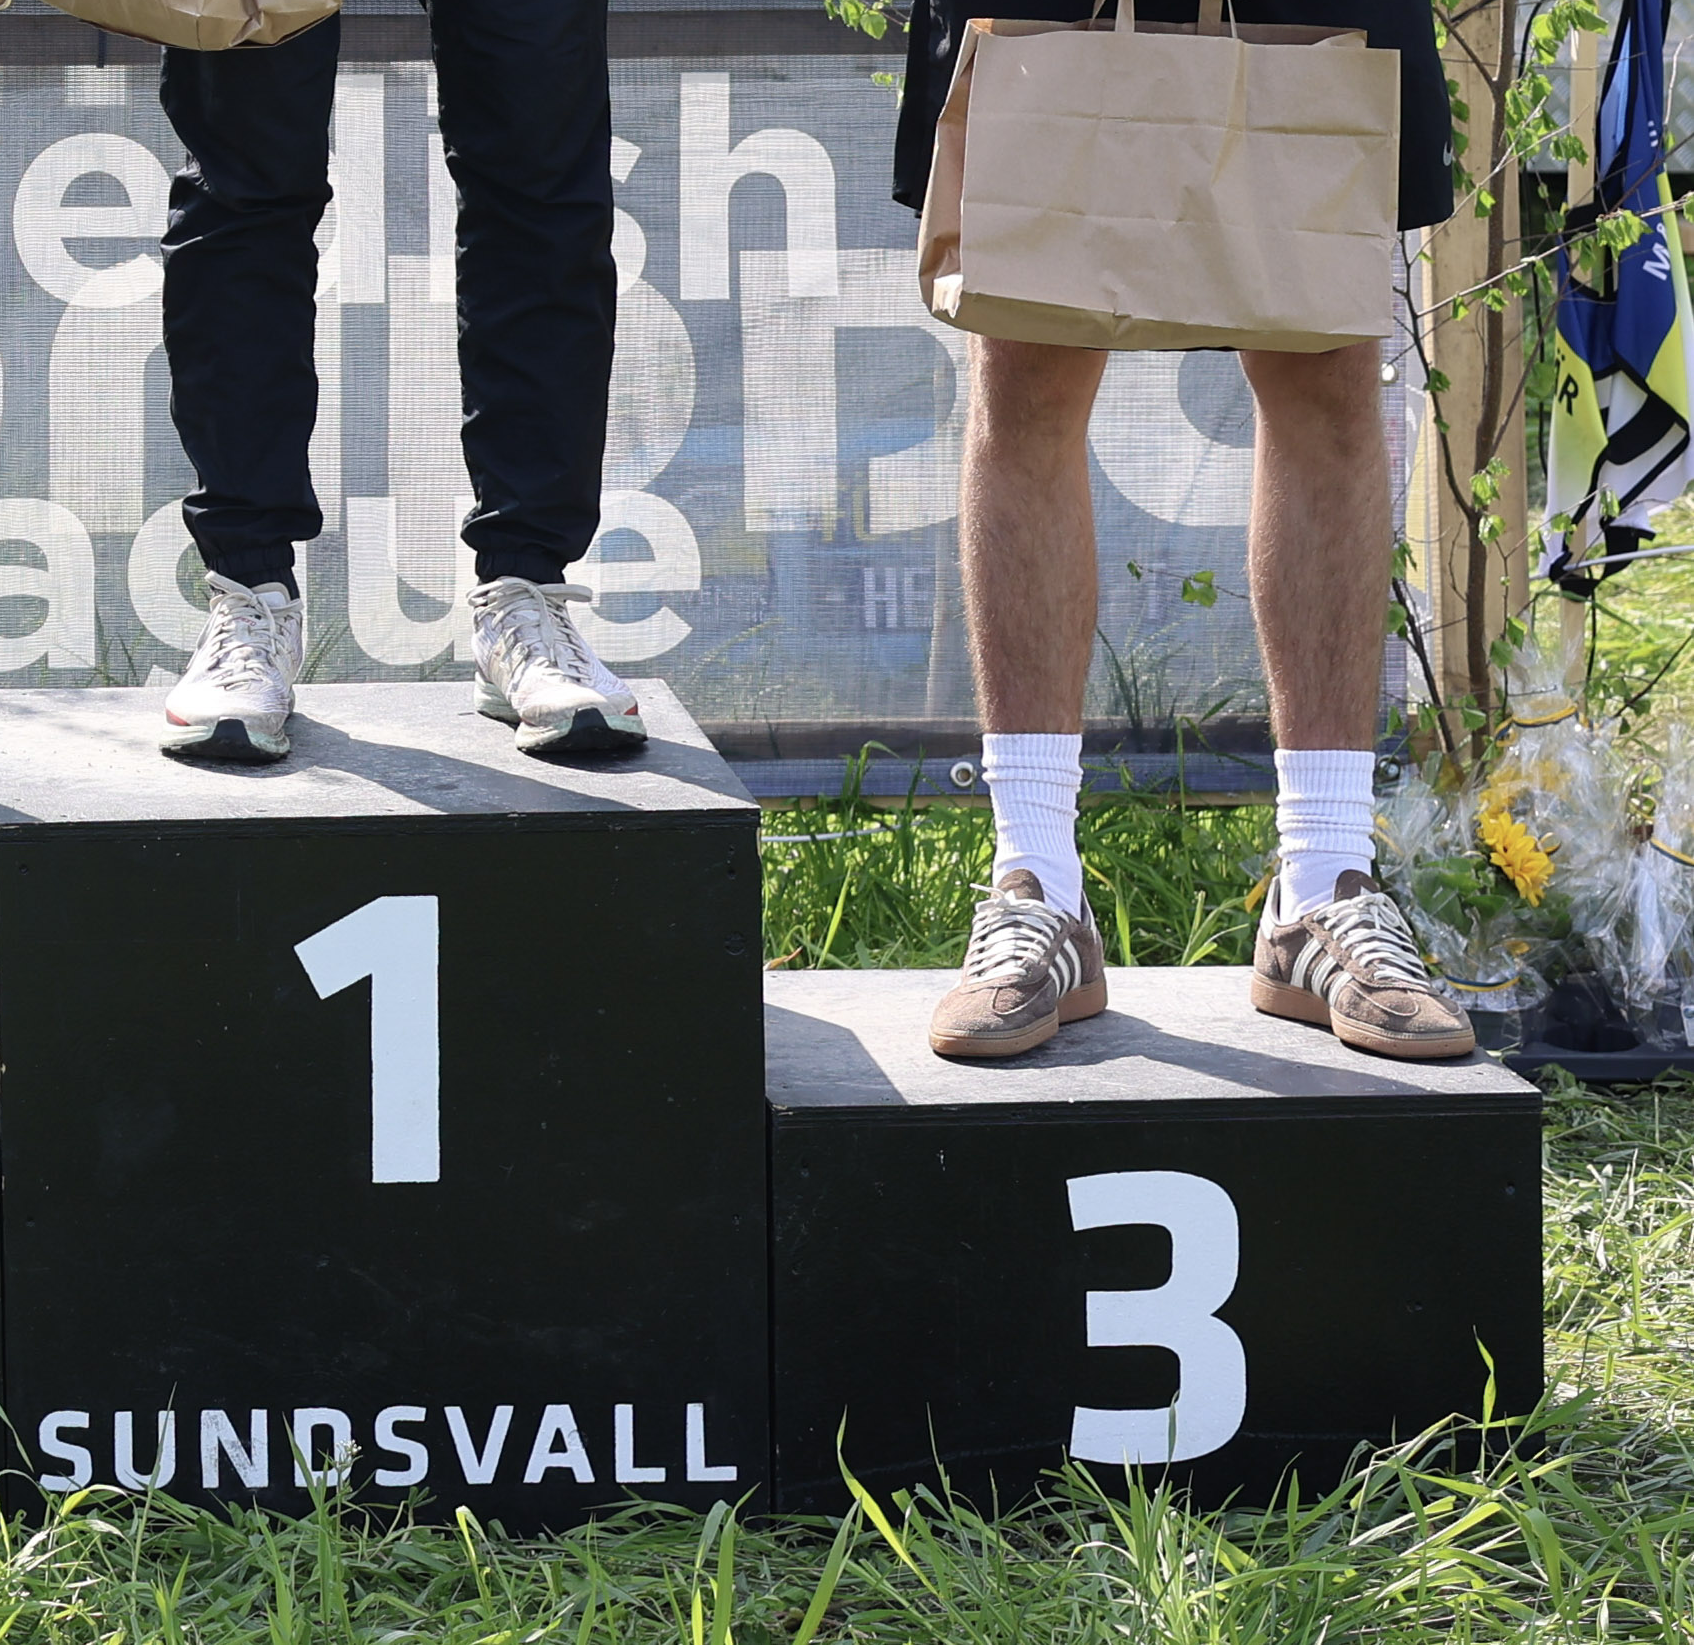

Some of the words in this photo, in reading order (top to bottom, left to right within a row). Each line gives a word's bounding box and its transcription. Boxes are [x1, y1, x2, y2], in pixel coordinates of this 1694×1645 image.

[294, 896, 440, 1183] 1
[37, 1402, 738, 1492] SUNDSVALL
[1067, 1171, 1246, 1463] 3
